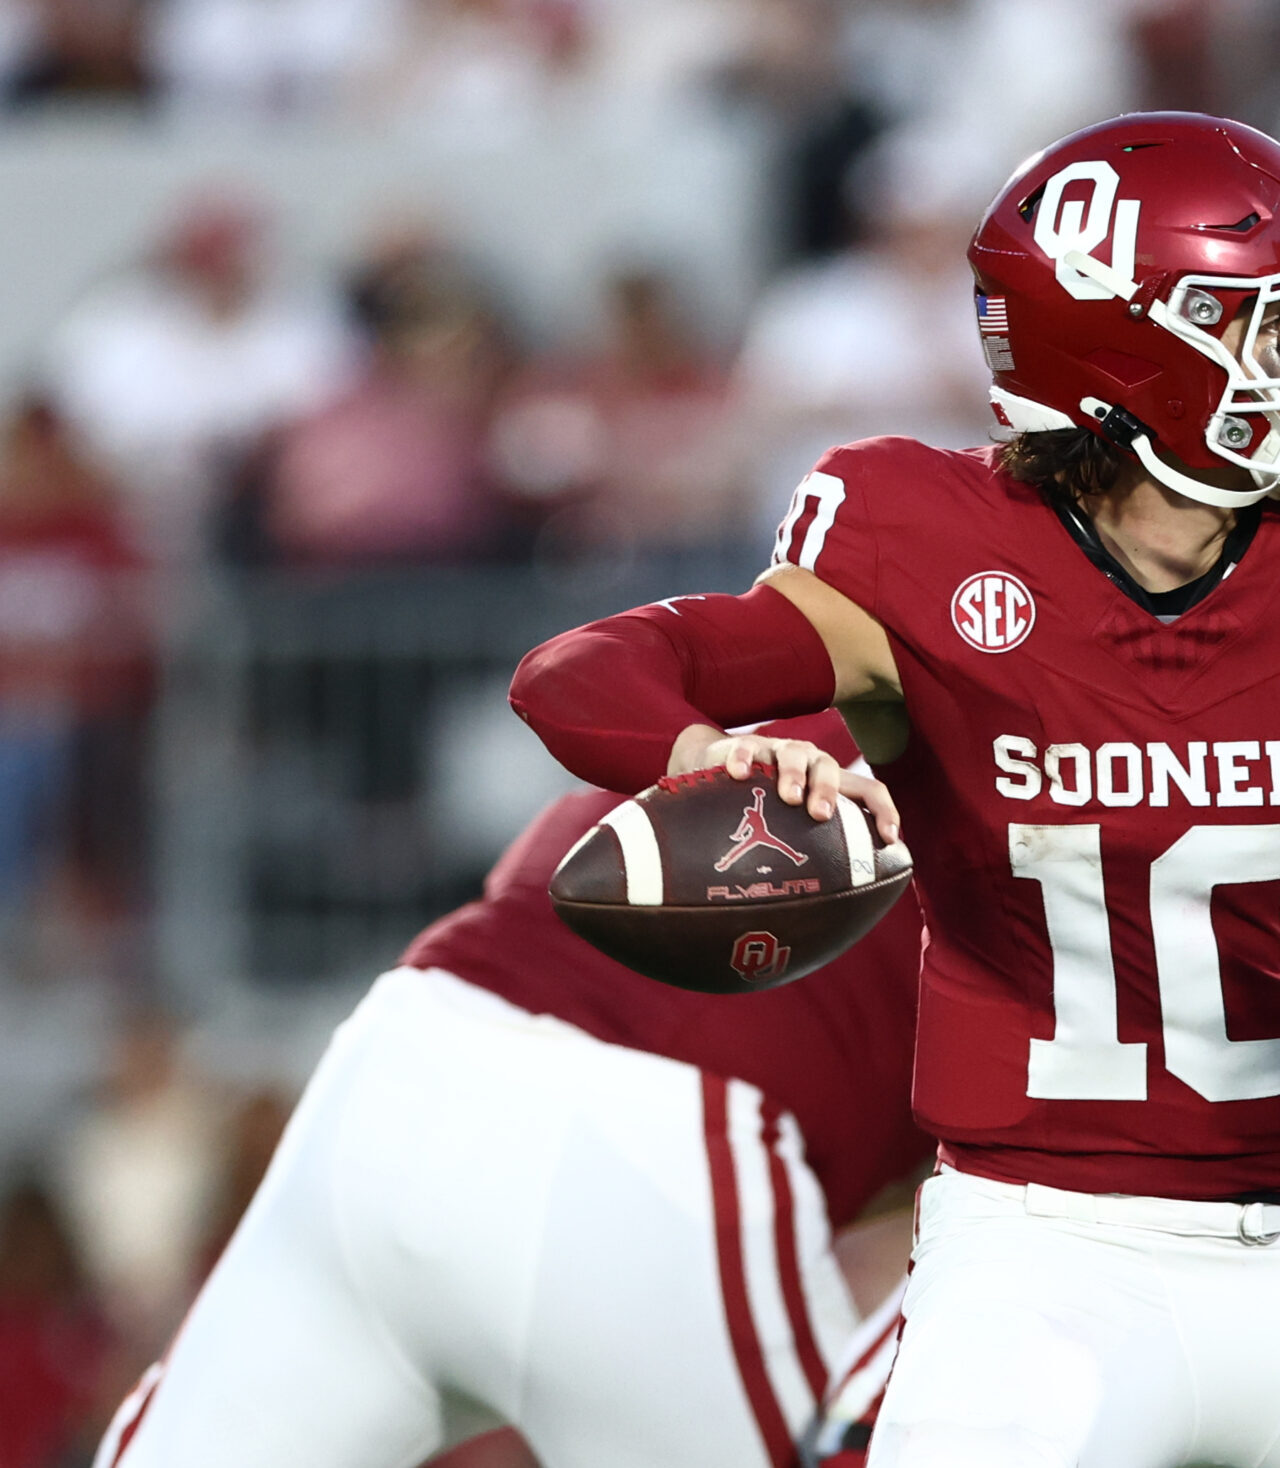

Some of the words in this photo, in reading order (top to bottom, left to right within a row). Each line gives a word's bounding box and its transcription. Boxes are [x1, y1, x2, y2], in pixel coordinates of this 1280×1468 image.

[1033, 160, 1141, 300] OU
[956, 576, 1029, 648] SEC
[730, 931, 791, 982] OU
